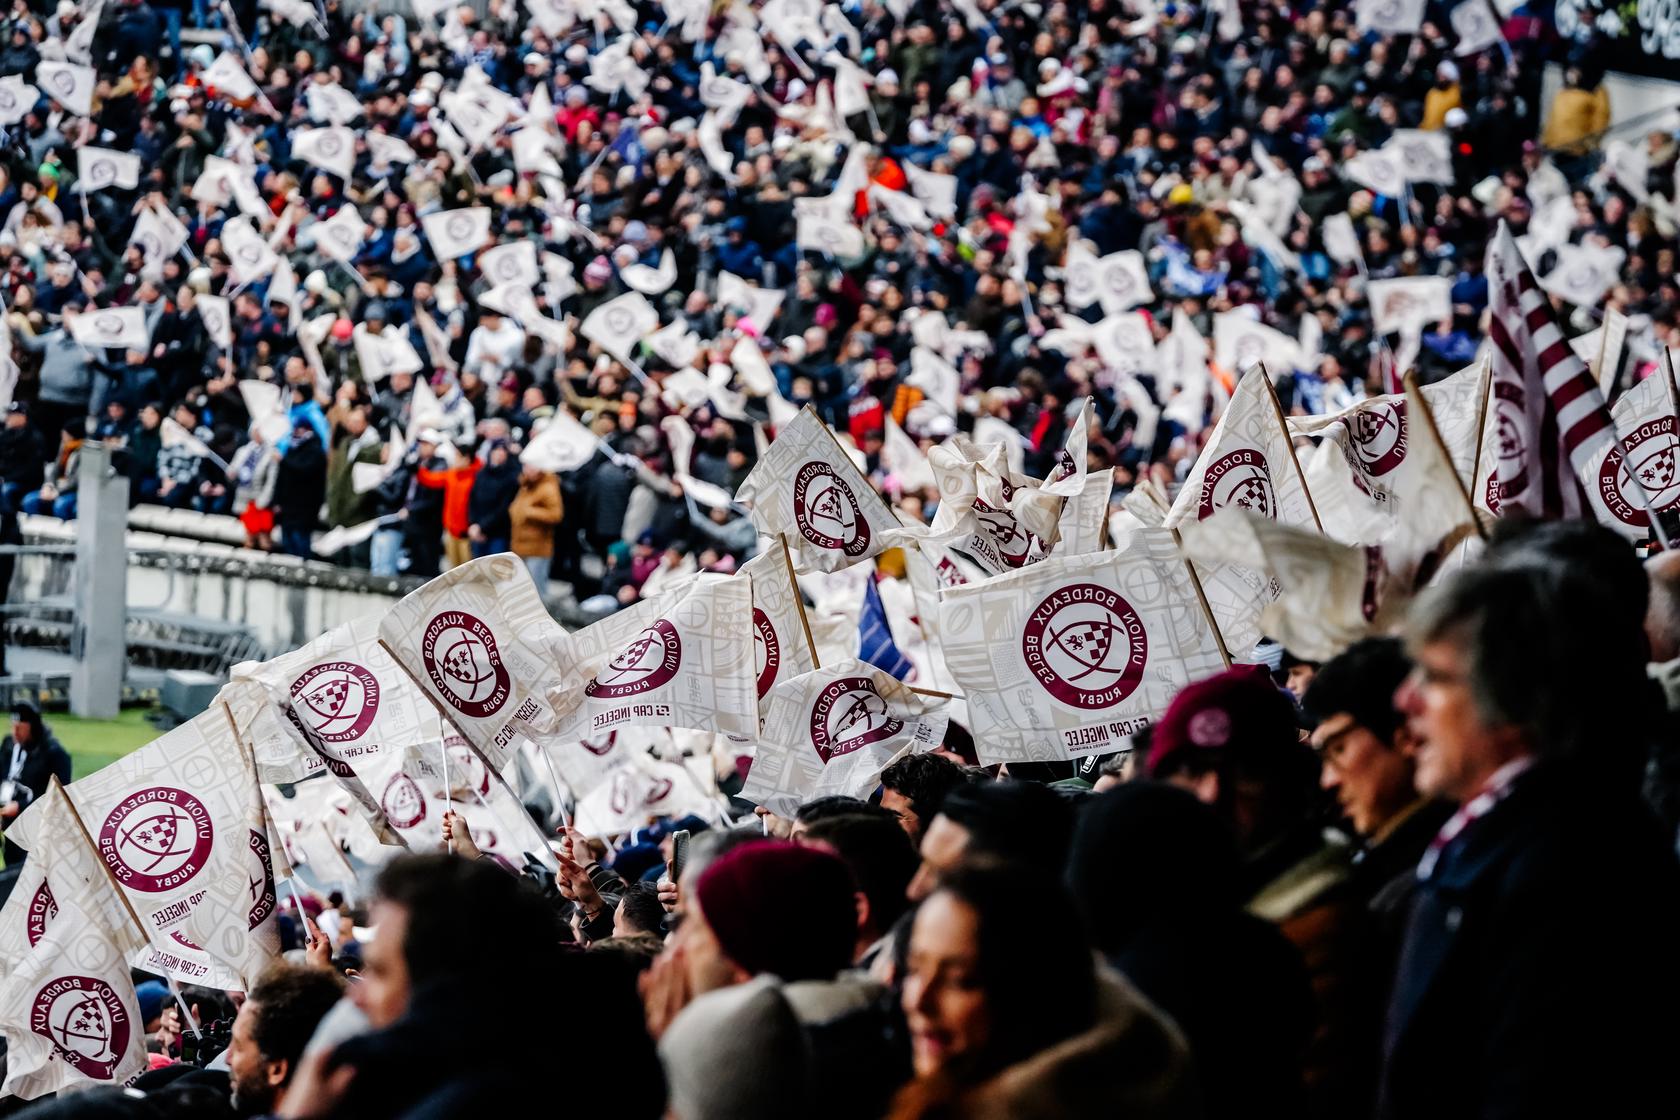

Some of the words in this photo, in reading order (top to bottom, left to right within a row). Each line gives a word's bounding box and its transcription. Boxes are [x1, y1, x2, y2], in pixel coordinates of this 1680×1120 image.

[424, 614, 465, 659] BORDEAUX
[472, 621, 500, 667] BEGLES
[430, 670, 462, 709] UNION
[482, 684, 507, 713] RUGBY
[512, 697, 538, 723] NGELEC
[249, 892, 275, 928] BEGL
